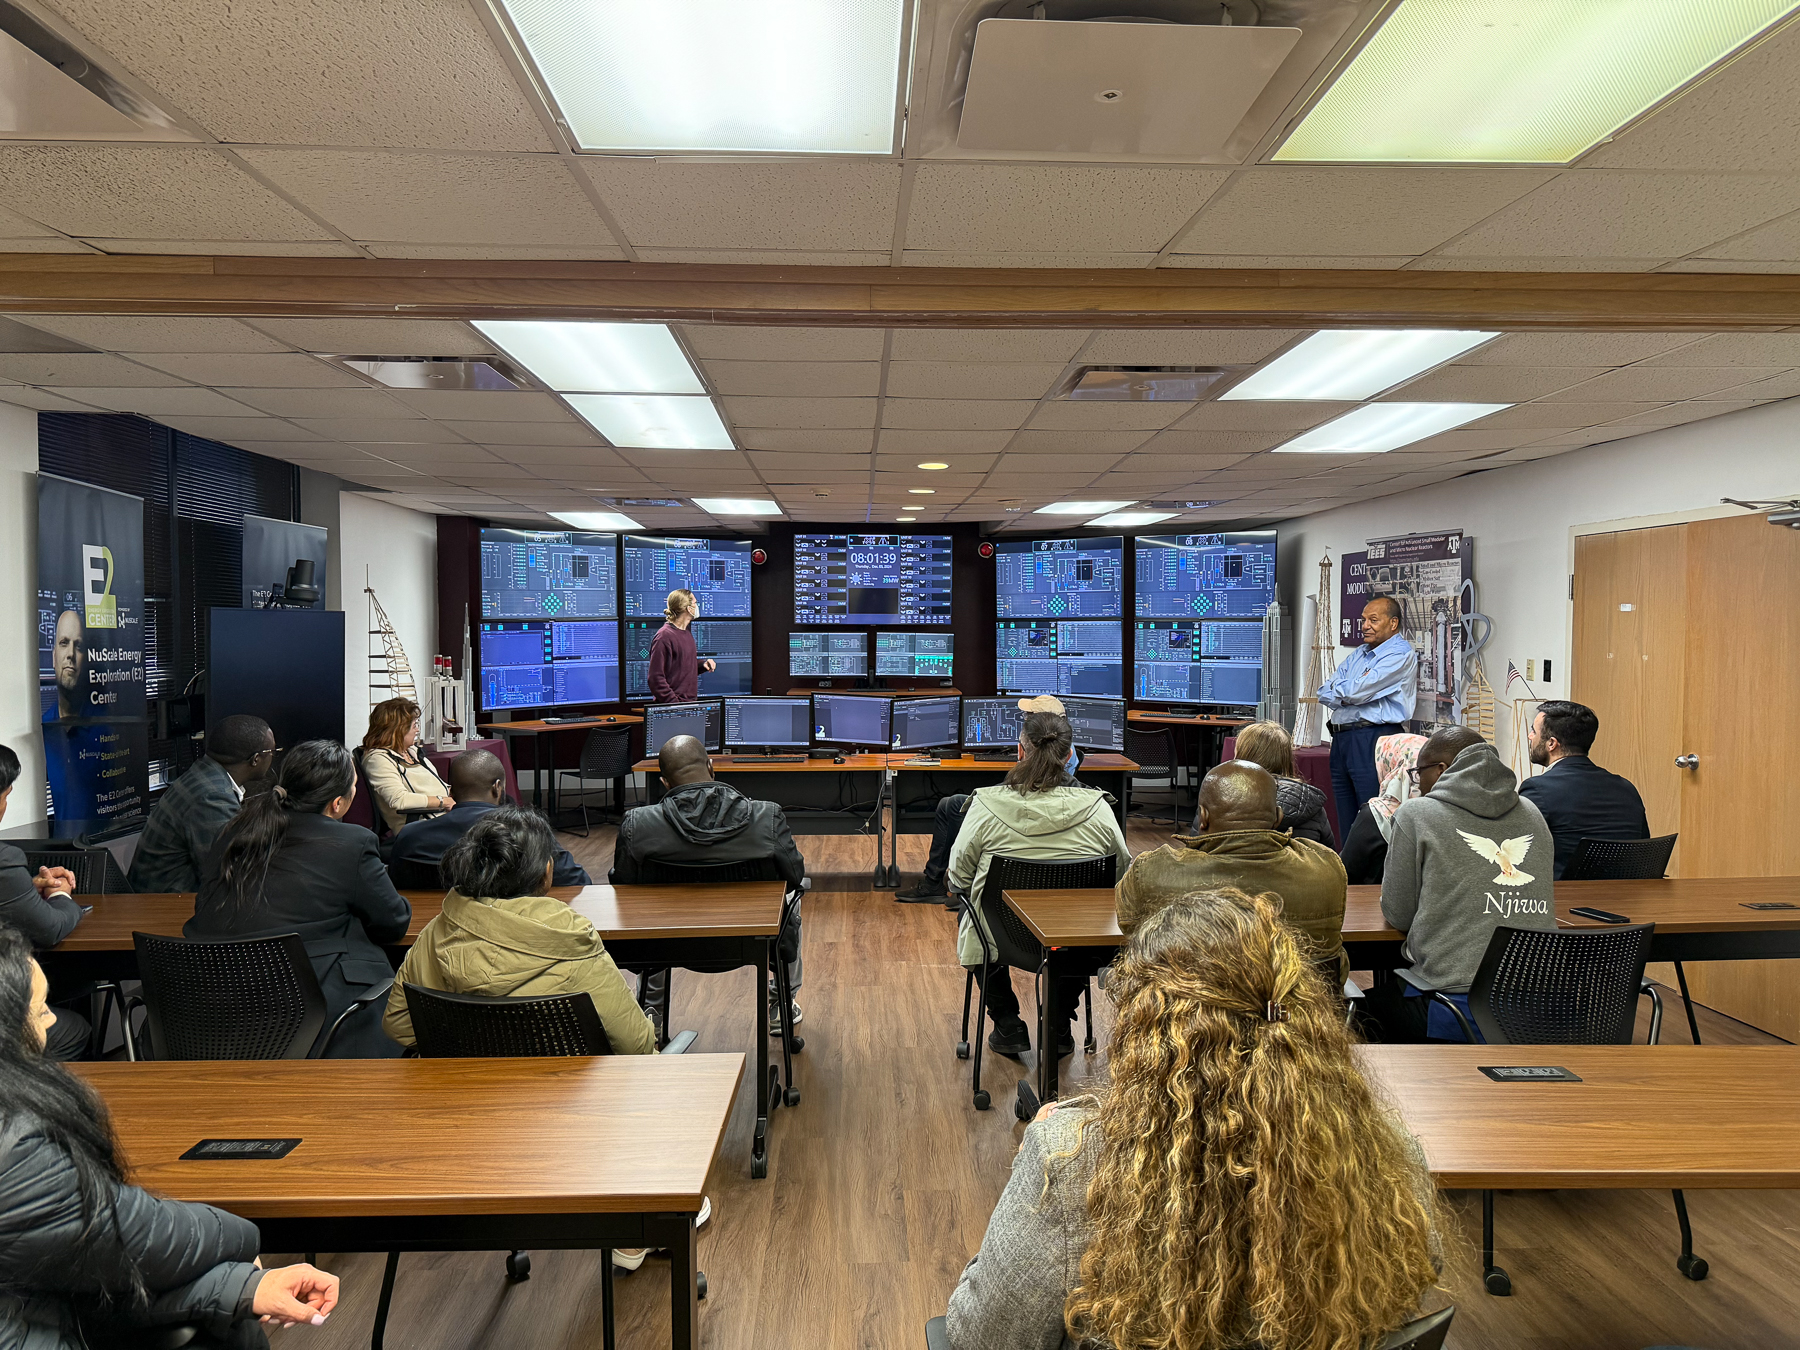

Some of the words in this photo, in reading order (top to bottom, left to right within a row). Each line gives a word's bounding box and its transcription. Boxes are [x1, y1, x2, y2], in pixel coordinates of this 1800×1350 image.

[851, 553, 896, 563] 08:01:39
[1367, 543, 1386, 559] TEES
[1349, 563, 1367, 576] CENT
[1346, 582, 1368, 595] MODU
[88, 613, 116, 626] CENTER
[87, 648, 118, 662] NuScale
[118, 648, 141, 664] Energy
[89, 668, 131, 686] Exploration
[131, 666, 144, 682] (E2)
[90, 690, 117, 705] Center
[97, 803, 117, 814] visitors
[1482, 891, 1549, 919] Njiwa
